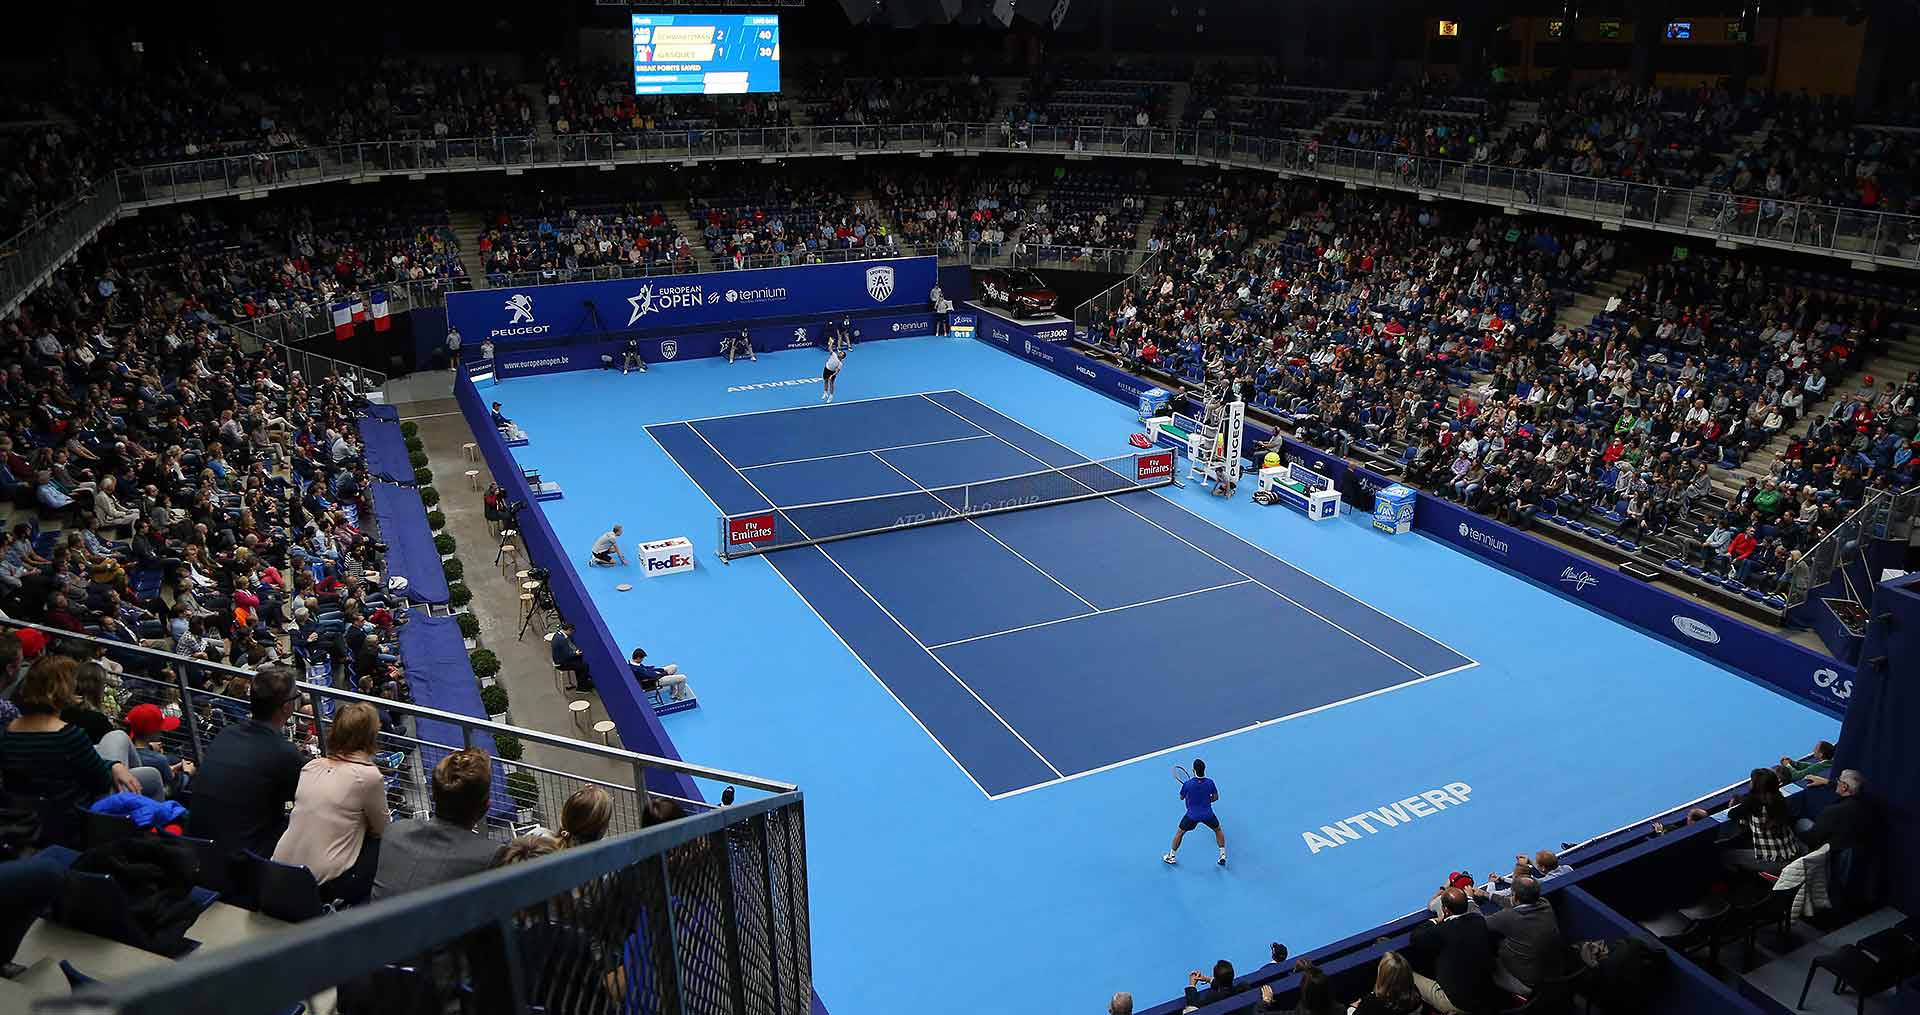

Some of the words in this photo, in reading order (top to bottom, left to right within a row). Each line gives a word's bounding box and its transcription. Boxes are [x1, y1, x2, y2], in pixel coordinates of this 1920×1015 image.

[716, 30, 724, 40] 2
[759, 30, 772, 40] 40
[718, 47, 724, 57] 1
[759, 47, 772, 57] 30
[658, 284, 702, 295] EUROPEAN
[738, 286, 787, 300] tennium
[658, 292, 703, 309] OPEN
[491, 325, 550, 337] PEUGEOT
[1050, 329, 1068, 338] 3008
[503, 356, 569, 370] www.europeanopen.be
[1076, 364, 1097, 378] HEAD
[1229, 410, 1241, 477] PEUGEOT
[1139, 464, 1170, 476] Emirates
[731, 527, 772, 541] Emirates
[1469, 527, 1508, 553] tennium
[643, 539, 688, 551] FedEx
[648, 553, 691, 571] FedEx
[1813, 667, 1854, 699] G4S
[1301, 781, 1473, 854] ANTWERP
